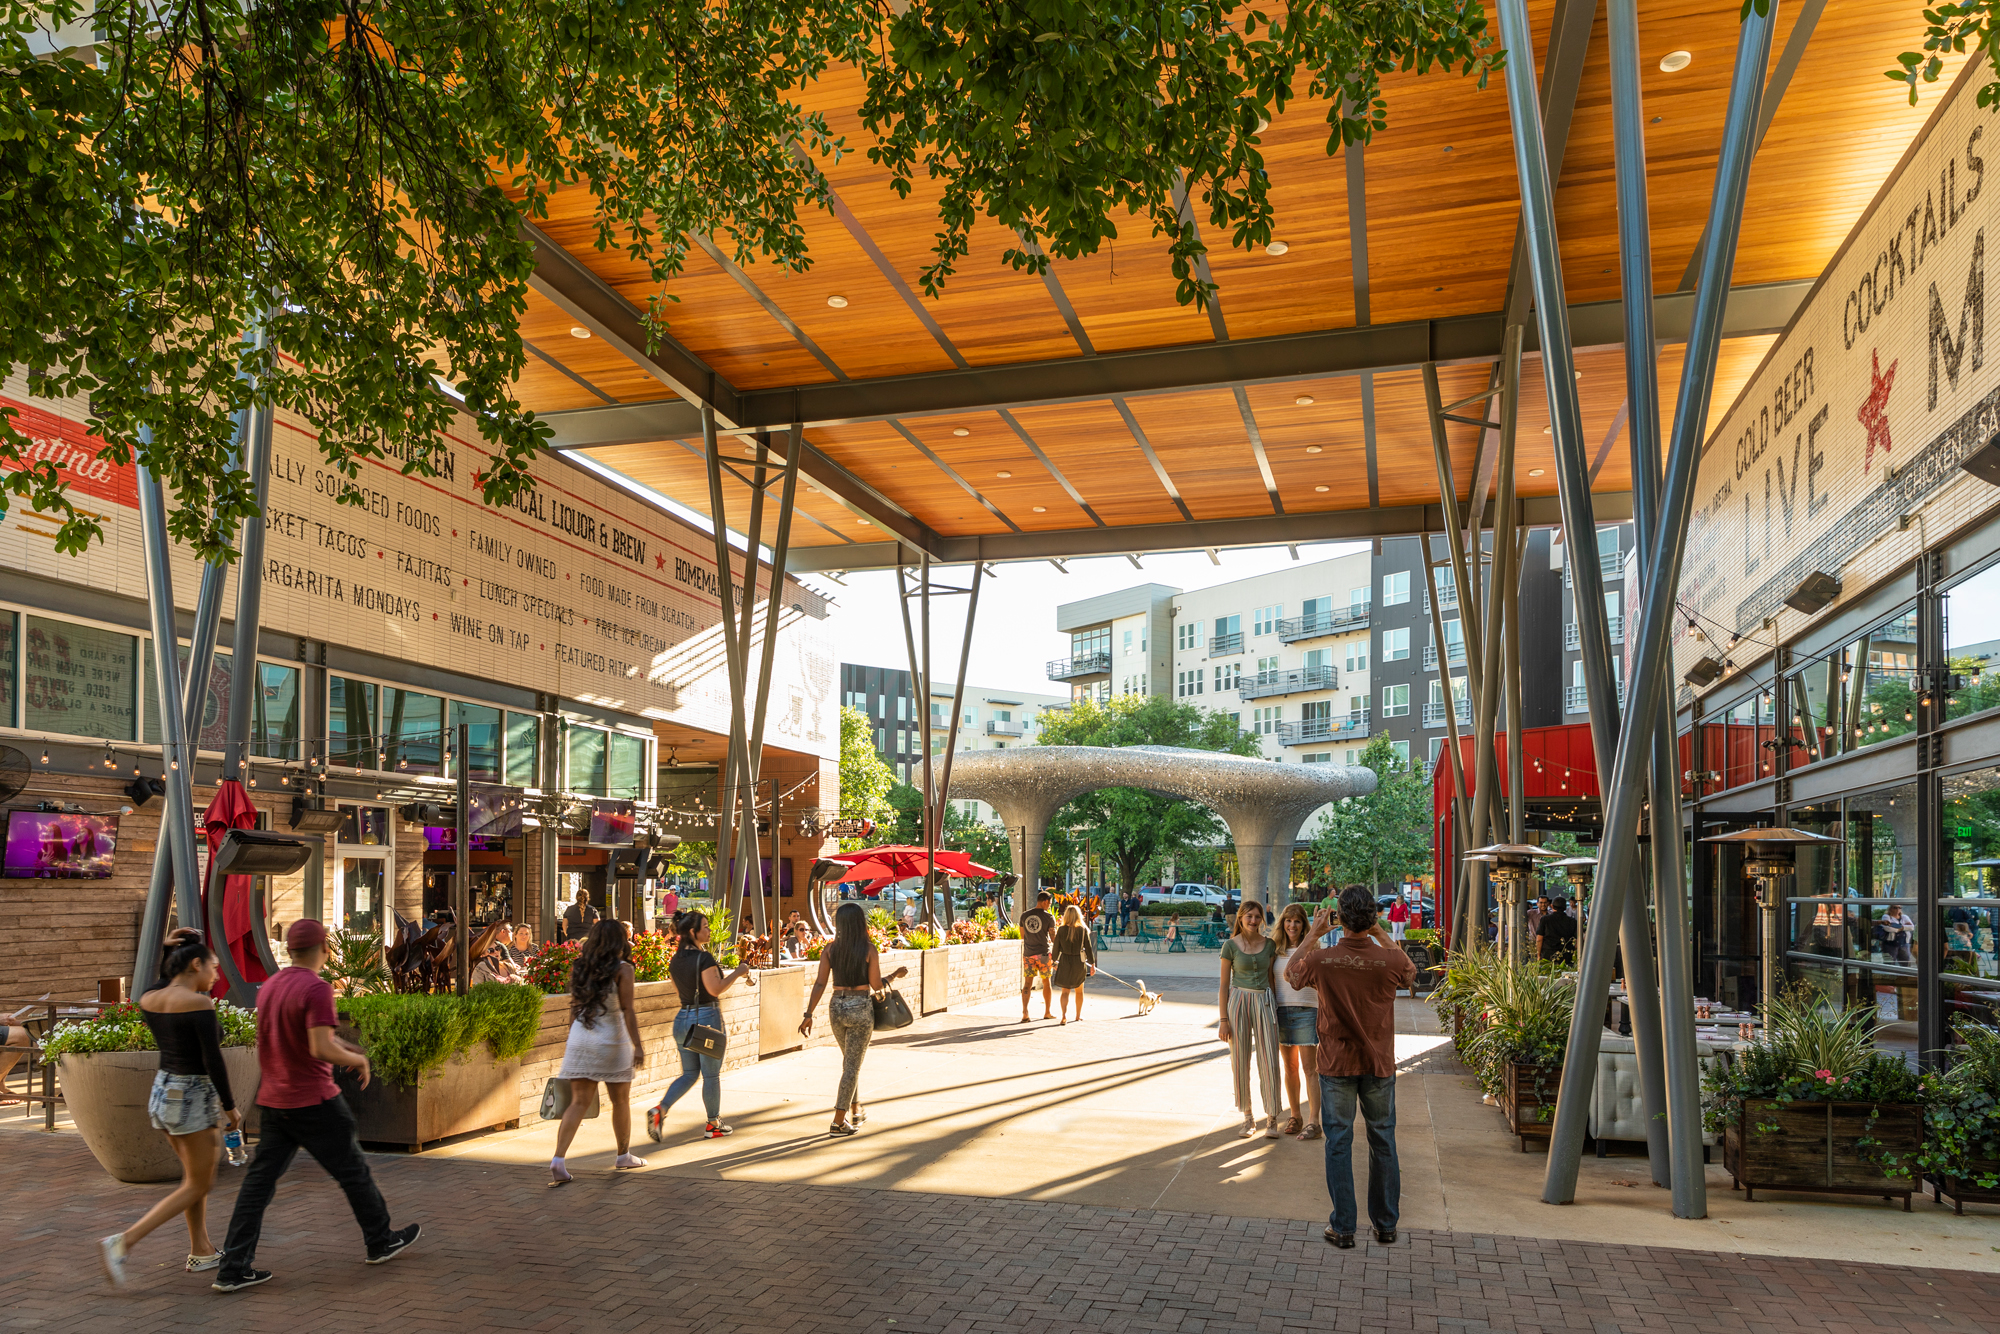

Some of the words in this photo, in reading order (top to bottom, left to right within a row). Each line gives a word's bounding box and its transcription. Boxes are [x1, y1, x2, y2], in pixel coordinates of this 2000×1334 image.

[1736, 405, 1769, 481] COLD
[1774, 346, 1814, 438] BEER
[1844, 125, 1984, 350] COCKTAILS
[4, 429, 111, 483] antina
[1745, 403, 1829, 578] LIVE
[1904, 431, 1963, 500] CHICKEN
[315, 522, 367, 559] TACOS
[397, 551, 451, 586] FAJITAS
[480, 579, 518, 608] LUNCH
[523, 594, 574, 626] SPECIALS
[595, 618, 618, 641] FREE
[622, 627, 635, 646] ICE
[639, 633, 666, 654] CREAM
[397, 501, 440, 536] FOODS
[470, 530, 512, 564] FAMILY
[517, 549, 556, 580] OWNED
[580, 573, 604, 598] FOOD
[608, 584, 632, 609] MADE
[636, 595, 658, 618] FROM
[661, 605, 695, 632] SCRATCH
[502, 486, 546, 522] OCAL
[552, 500, 596, 544] LIQUOR
[600, 523, 608, 548] &
[612, 528, 646, 565] BREW
[675, 557, 721, 597] HOMEMA
[354, 584, 420, 622] MONDAYS
[450, 612, 482, 639] WINE
[489, 624, 504, 646] ON
[509, 629, 530, 651] TAP
[555, 643, 605, 673] FEATURED
[608, 659, 633, 680] RITAS
[1957, 826, 1972, 837] EXIT
